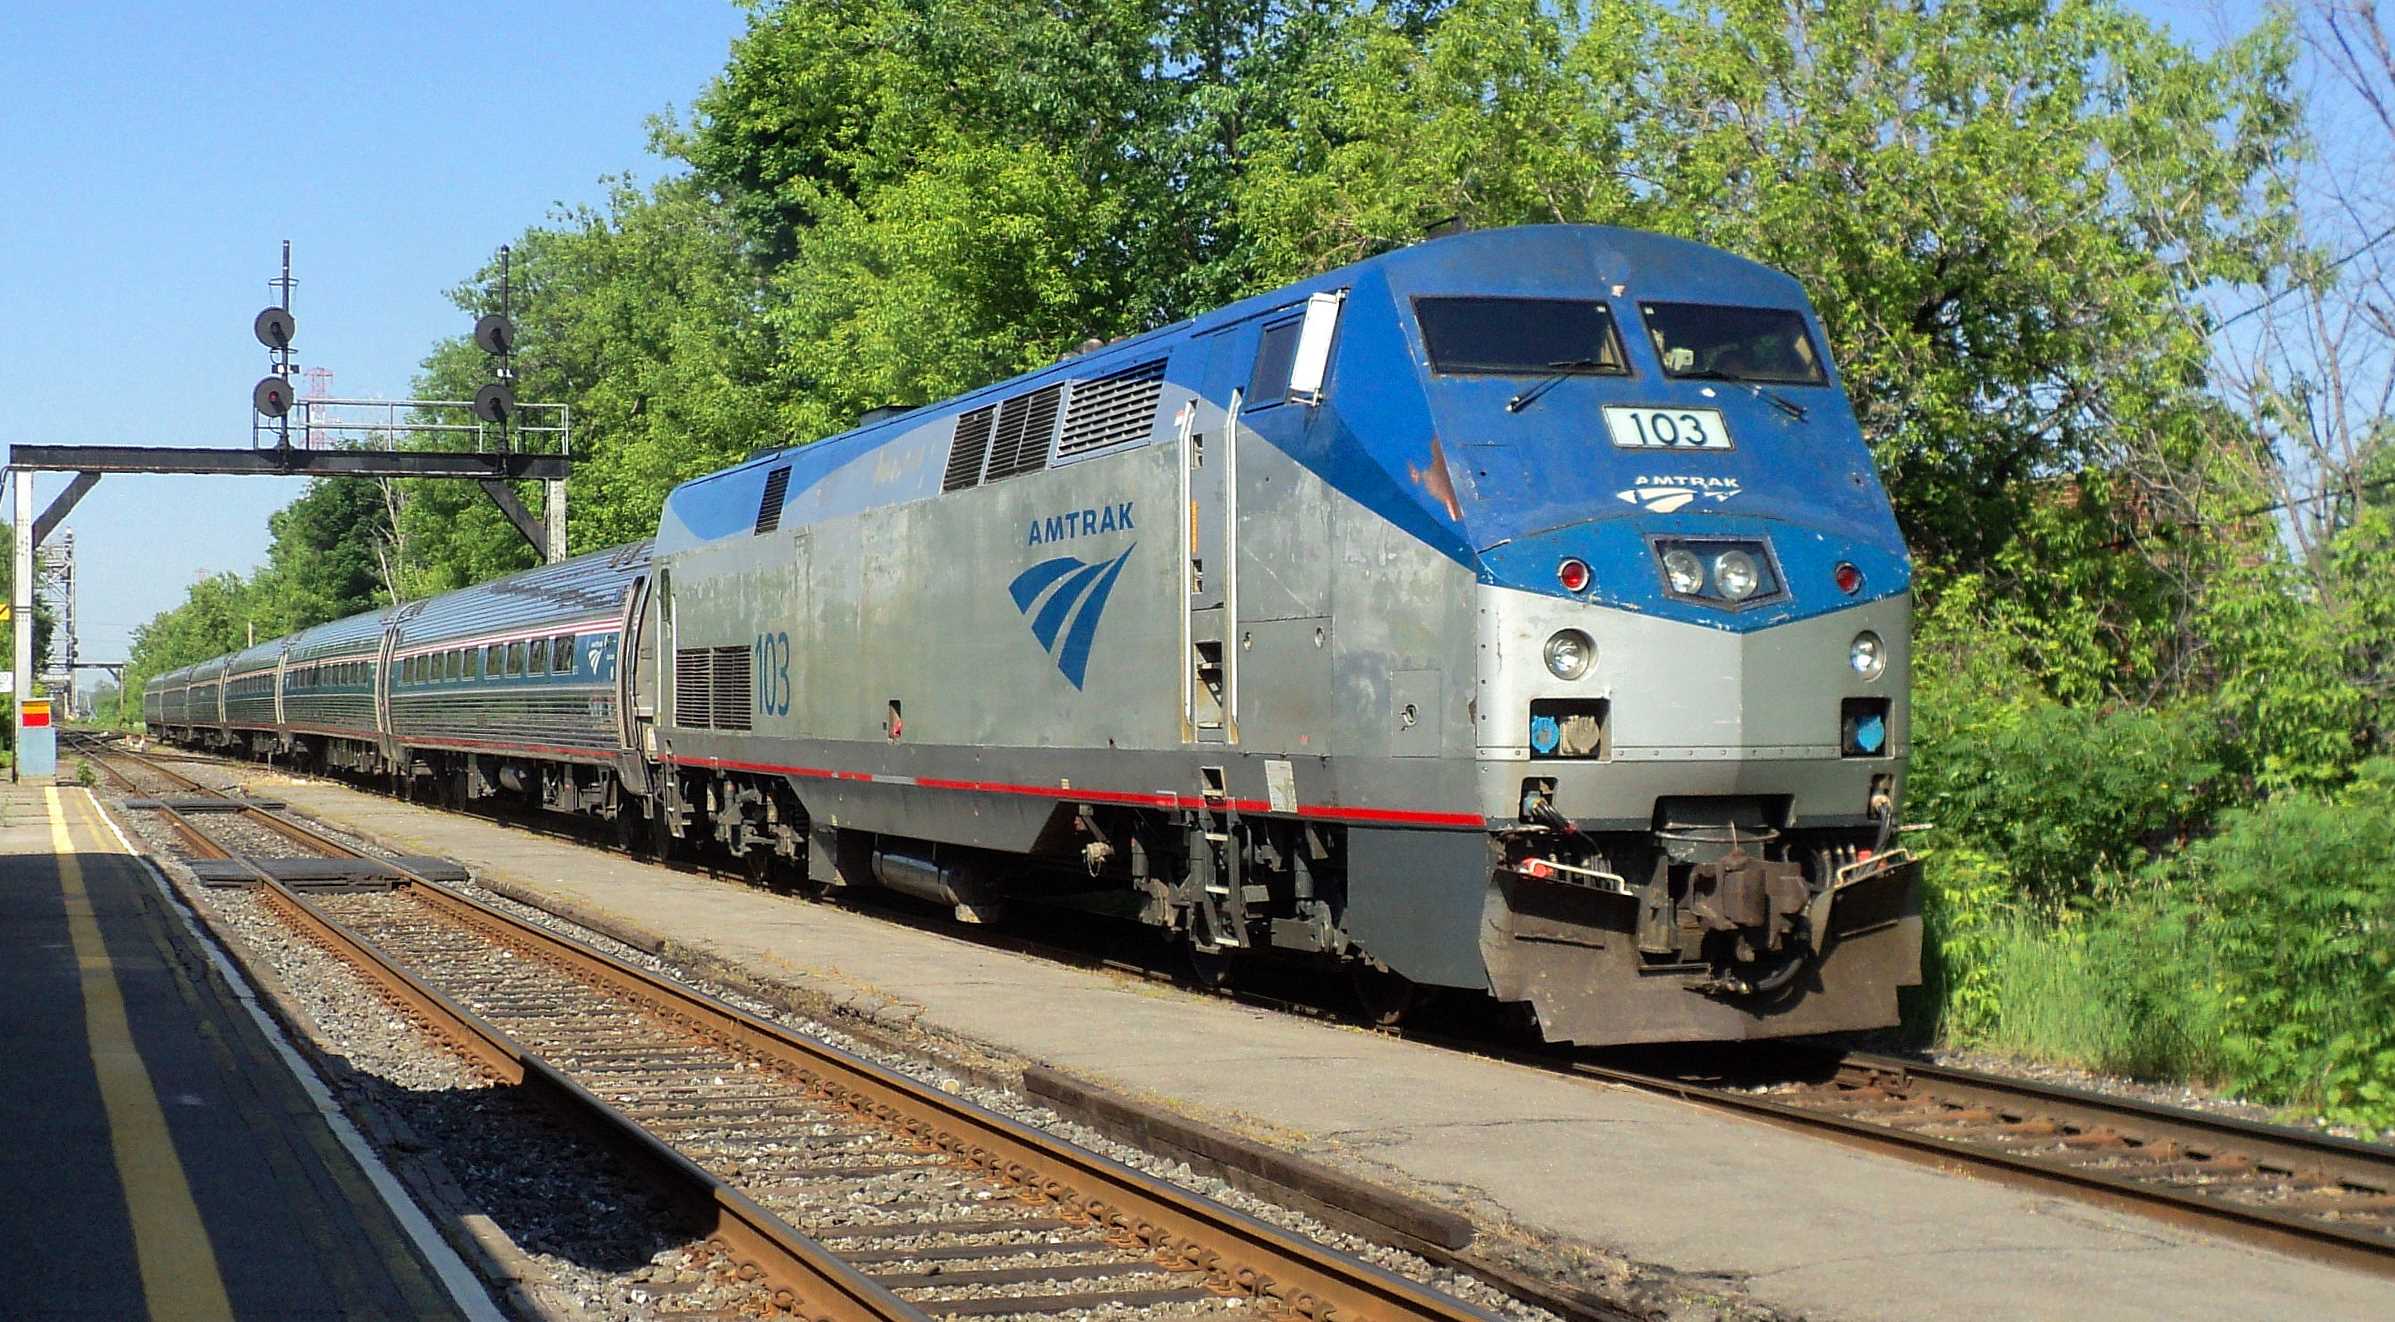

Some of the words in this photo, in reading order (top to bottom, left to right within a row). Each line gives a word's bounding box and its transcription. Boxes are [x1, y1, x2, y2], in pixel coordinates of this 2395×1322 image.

[1630, 413, 1707, 445] 103
[1635, 475, 1739, 488] AMTRAK
[1028, 501, 1135, 546] AMTRAK
[755, 632, 789, 716] 103
